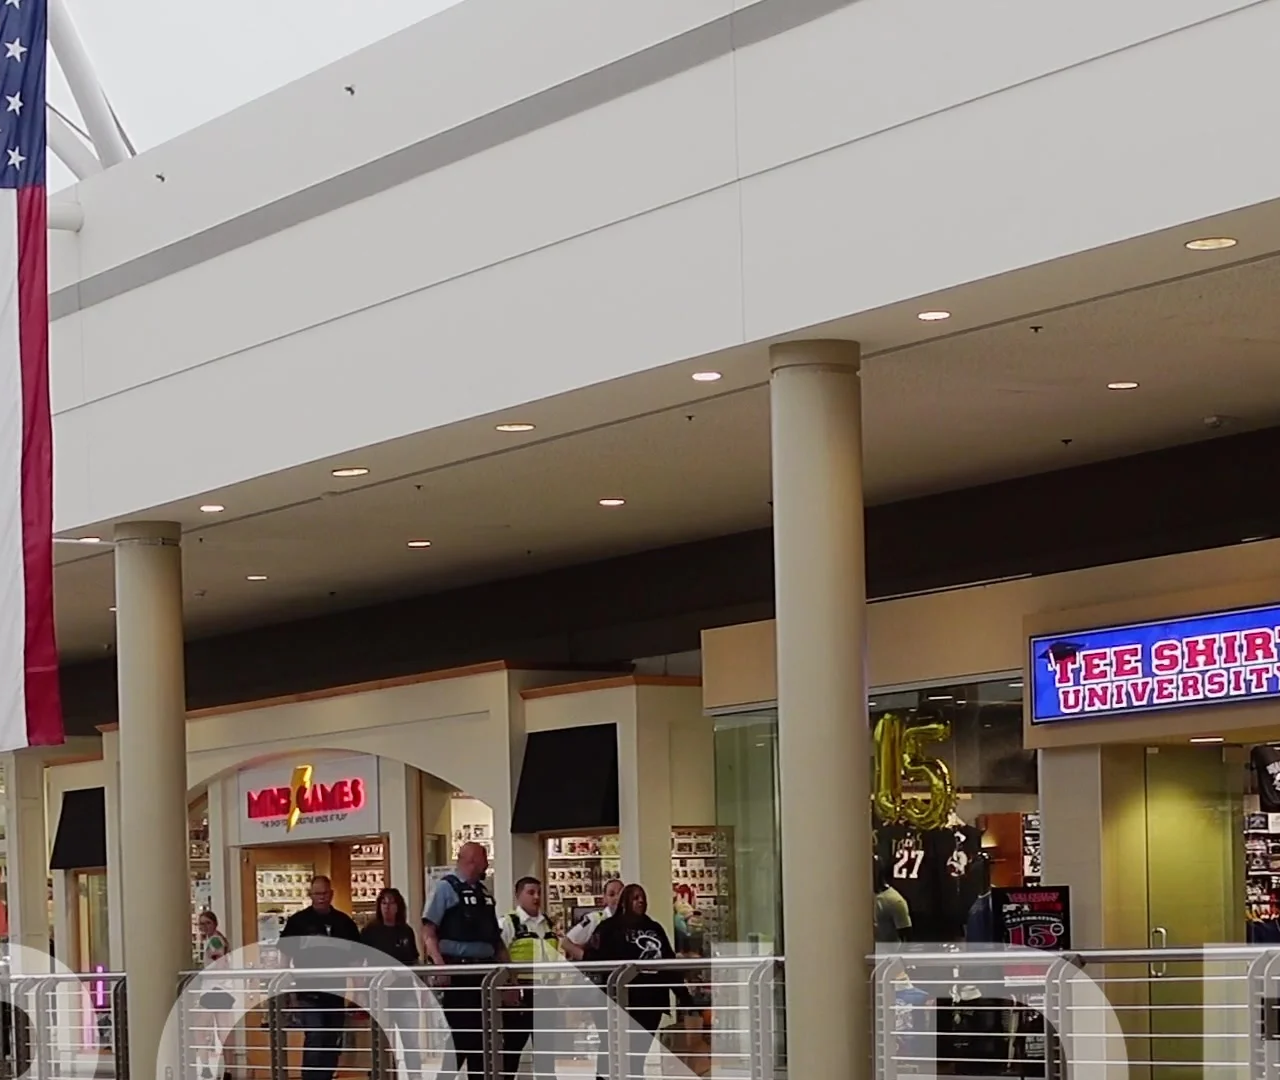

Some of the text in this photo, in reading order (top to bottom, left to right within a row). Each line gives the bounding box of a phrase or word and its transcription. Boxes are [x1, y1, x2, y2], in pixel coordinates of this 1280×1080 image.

[1054, 644, 1142, 687] TEE
[296, 778, 366, 814] GAMES
[893, 850, 924, 879] 27
